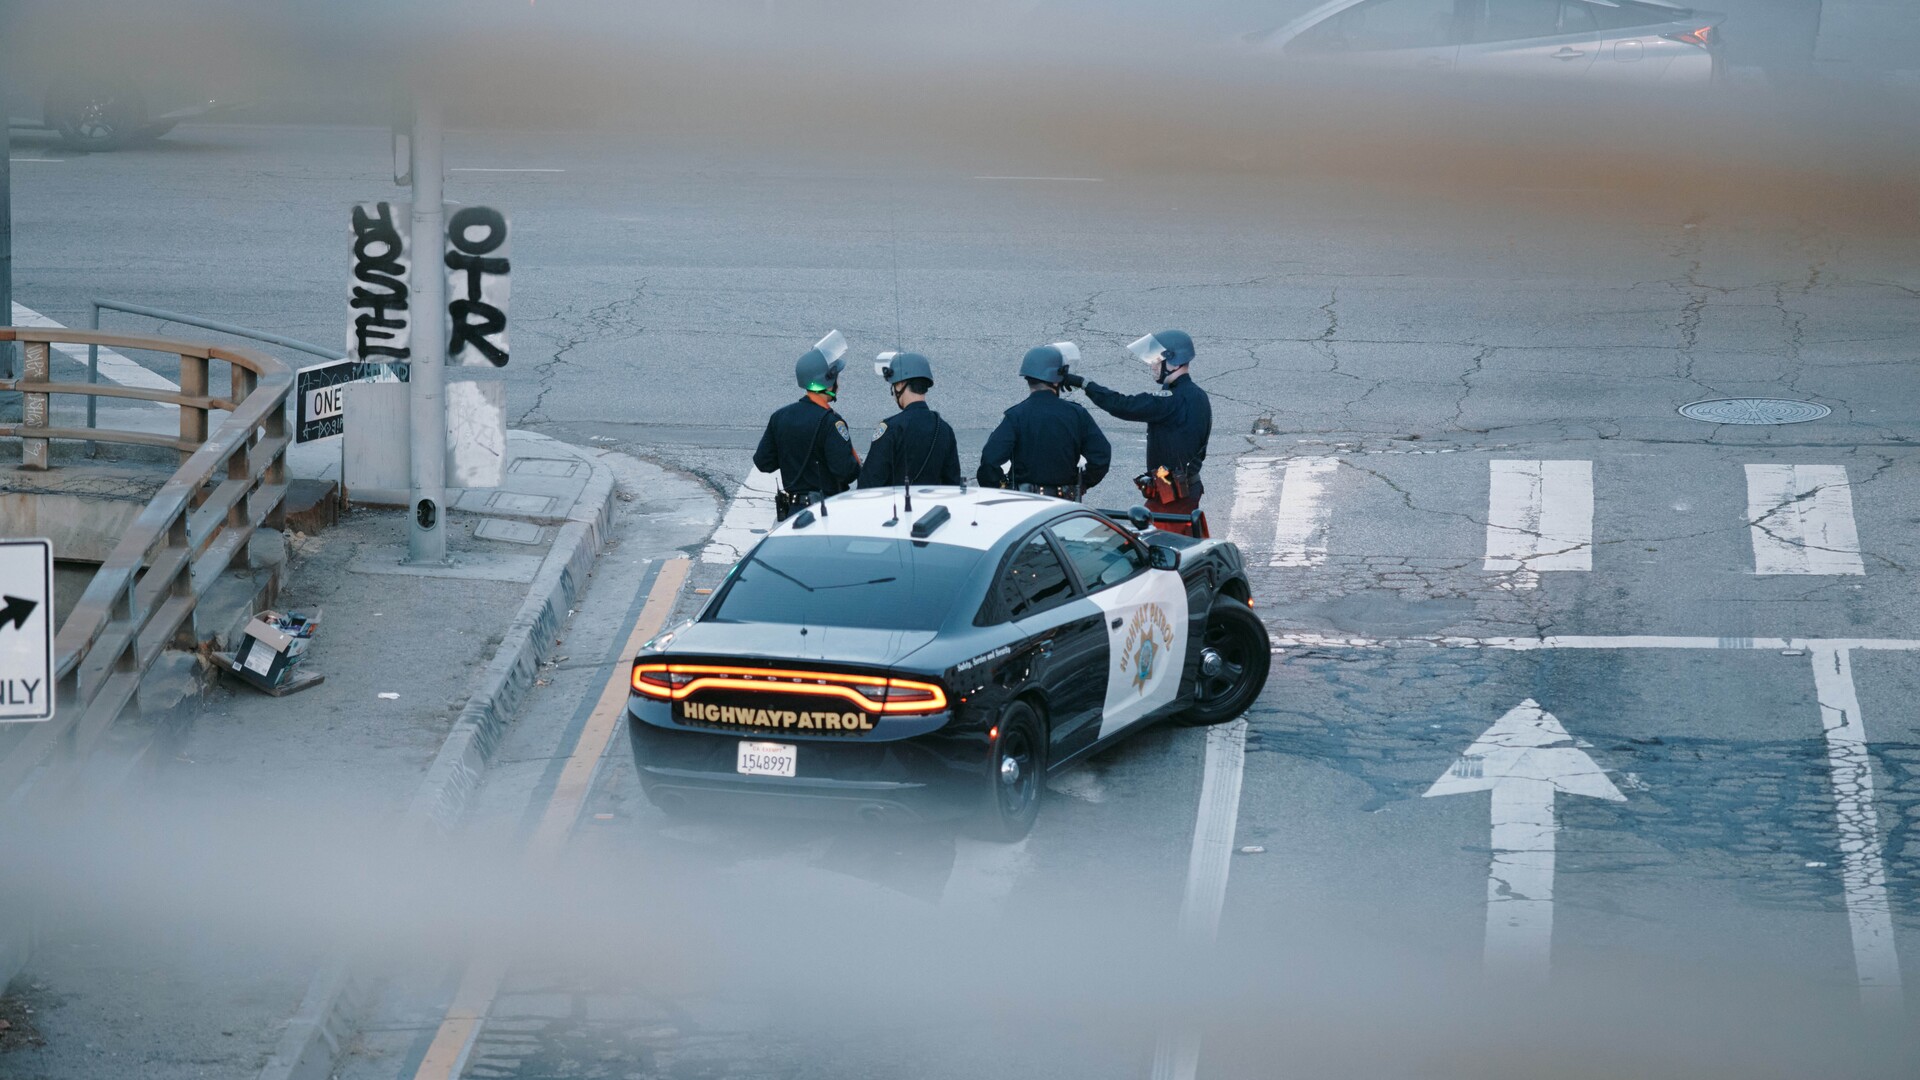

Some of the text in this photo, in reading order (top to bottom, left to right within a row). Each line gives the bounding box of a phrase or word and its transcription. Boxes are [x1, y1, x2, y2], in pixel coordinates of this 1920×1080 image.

[445, 206, 511, 367] OTR
[315, 388, 342, 415] ONE
[1120, 602, 1174, 673] HIGHWAY PATROL
[0, 679, 41, 705] LY
[742, 753, 792, 772] 1548997
